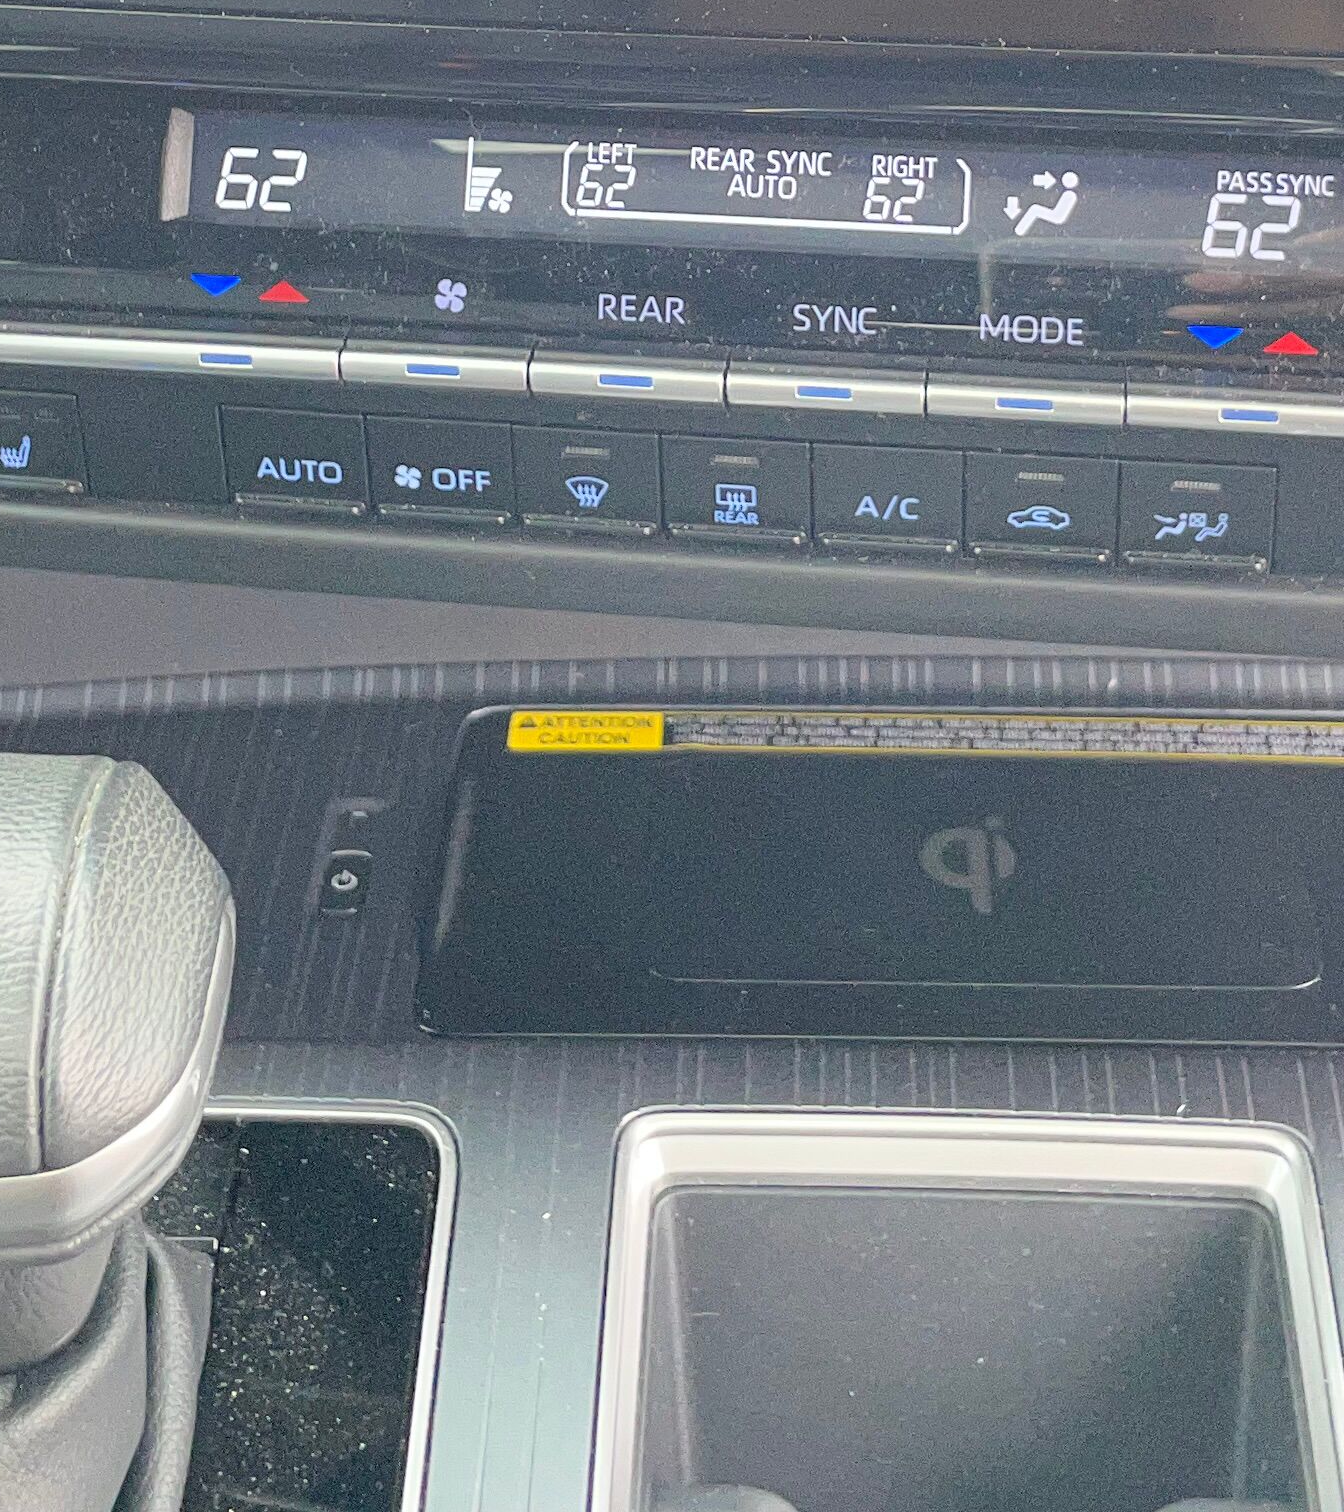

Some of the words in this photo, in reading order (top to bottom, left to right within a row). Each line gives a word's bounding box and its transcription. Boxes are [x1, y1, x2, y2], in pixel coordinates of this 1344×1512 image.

[587, 143, 637, 165] LEFT
[690, 147, 755, 172] REAR
[767, 150, 833, 177] SYNC
[872, 155, 938, 179] RIGHT
[215, 146, 308, 213] 62
[576, 163, 637, 209] 62
[727, 175, 797, 200] AUTO
[1216, 170, 1273, 194] PASS
[1275, 174, 1335, 197] SYNC
[862, 177, 924, 222] 62
[1202, 192, 1301, 261] 62
[598, 293, 686, 324] REAR
[793, 305, 878, 335] SYNC
[980, 314, 1083, 346] MODE
[256, 456, 343, 485] AUTO
[431, 468, 492, 491] OFF
[713, 510, 759, 525] REAR
[855, 495, 920, 522] A/C
